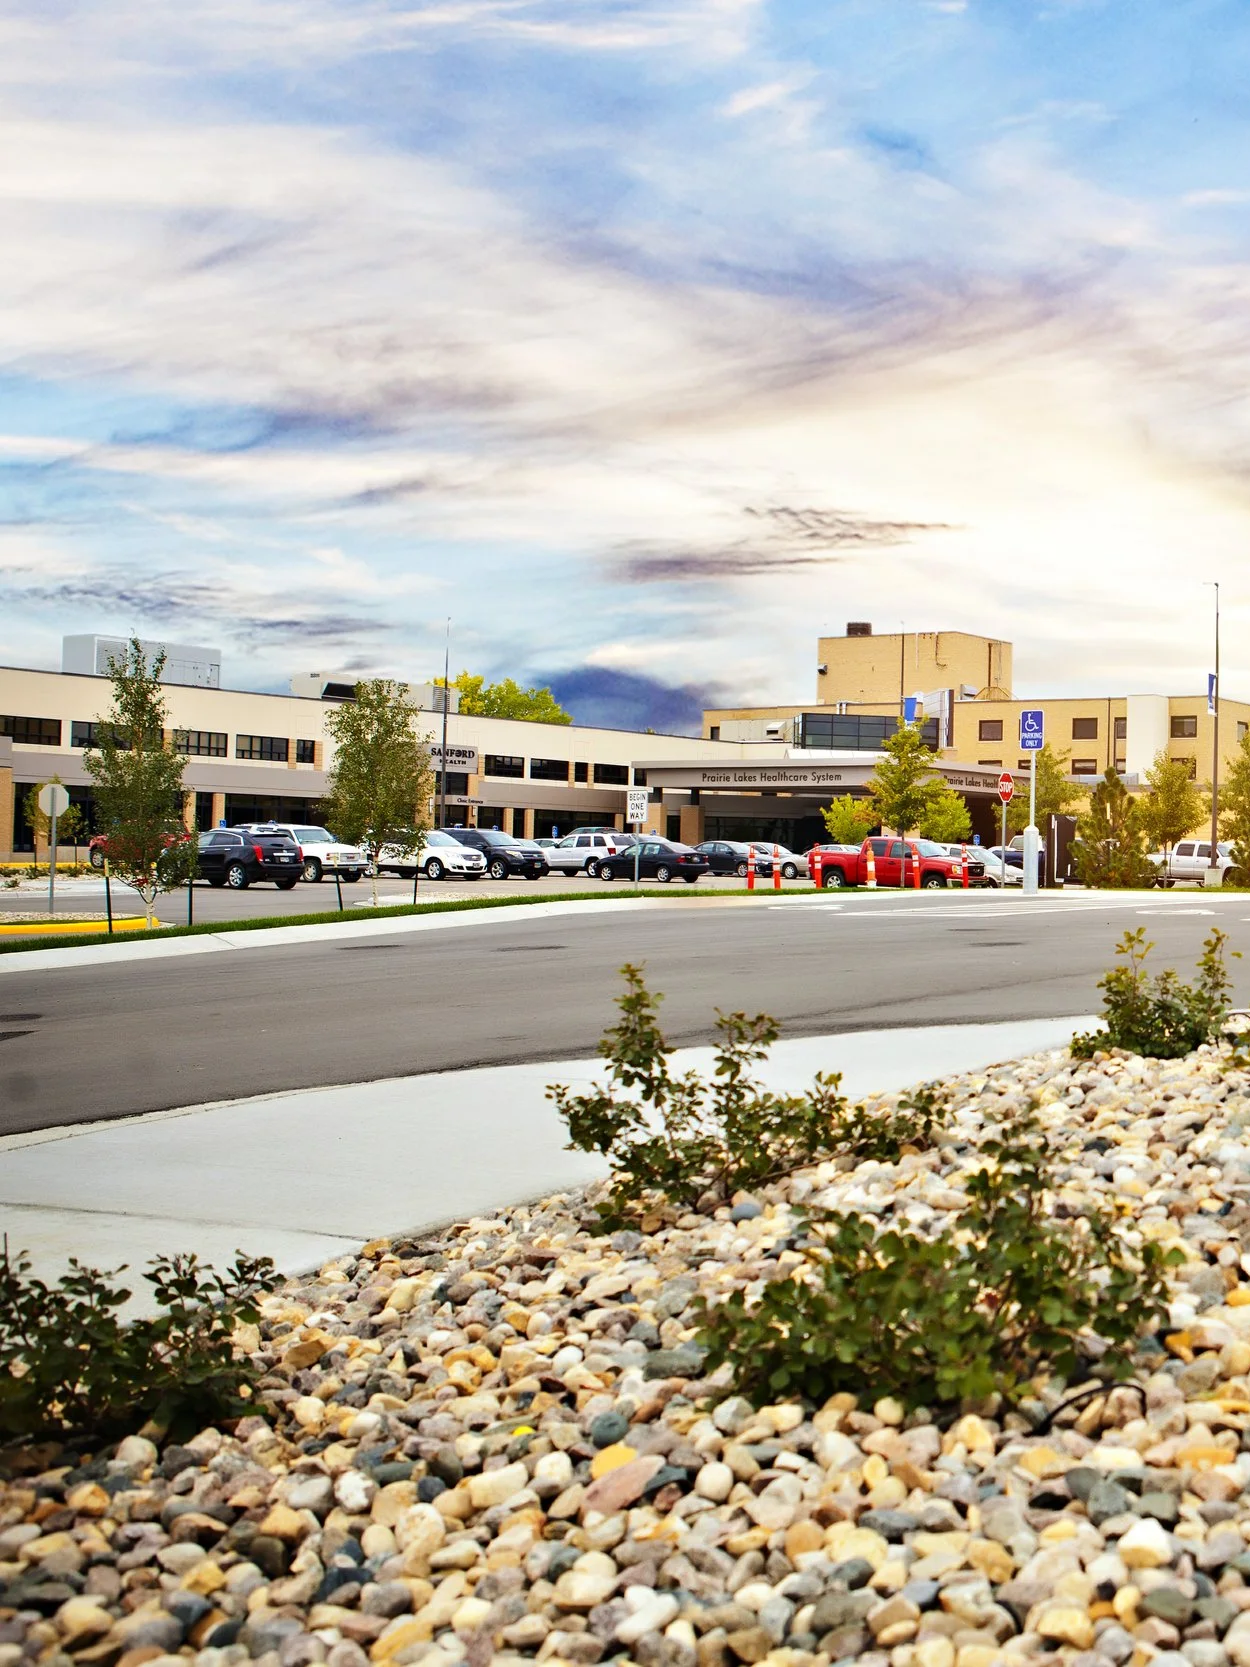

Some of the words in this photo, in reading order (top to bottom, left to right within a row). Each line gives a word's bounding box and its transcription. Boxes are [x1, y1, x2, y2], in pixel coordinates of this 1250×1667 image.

[1021, 732, 1043, 740] PARKING
[431, 748, 475, 759] SANFORD
[702, 773, 731, 782] Prairie
[733, 772, 757, 782] Lakes
[760, 771, 808, 782] Healthcare
[811, 771, 842, 784] System
[965, 776, 981, 787] Lakes
[999, 781, 1013, 793] STOP
[629, 793, 646, 801] BEGIN
[630, 802, 644, 810] ONE
[630, 812, 644, 820] WAY
